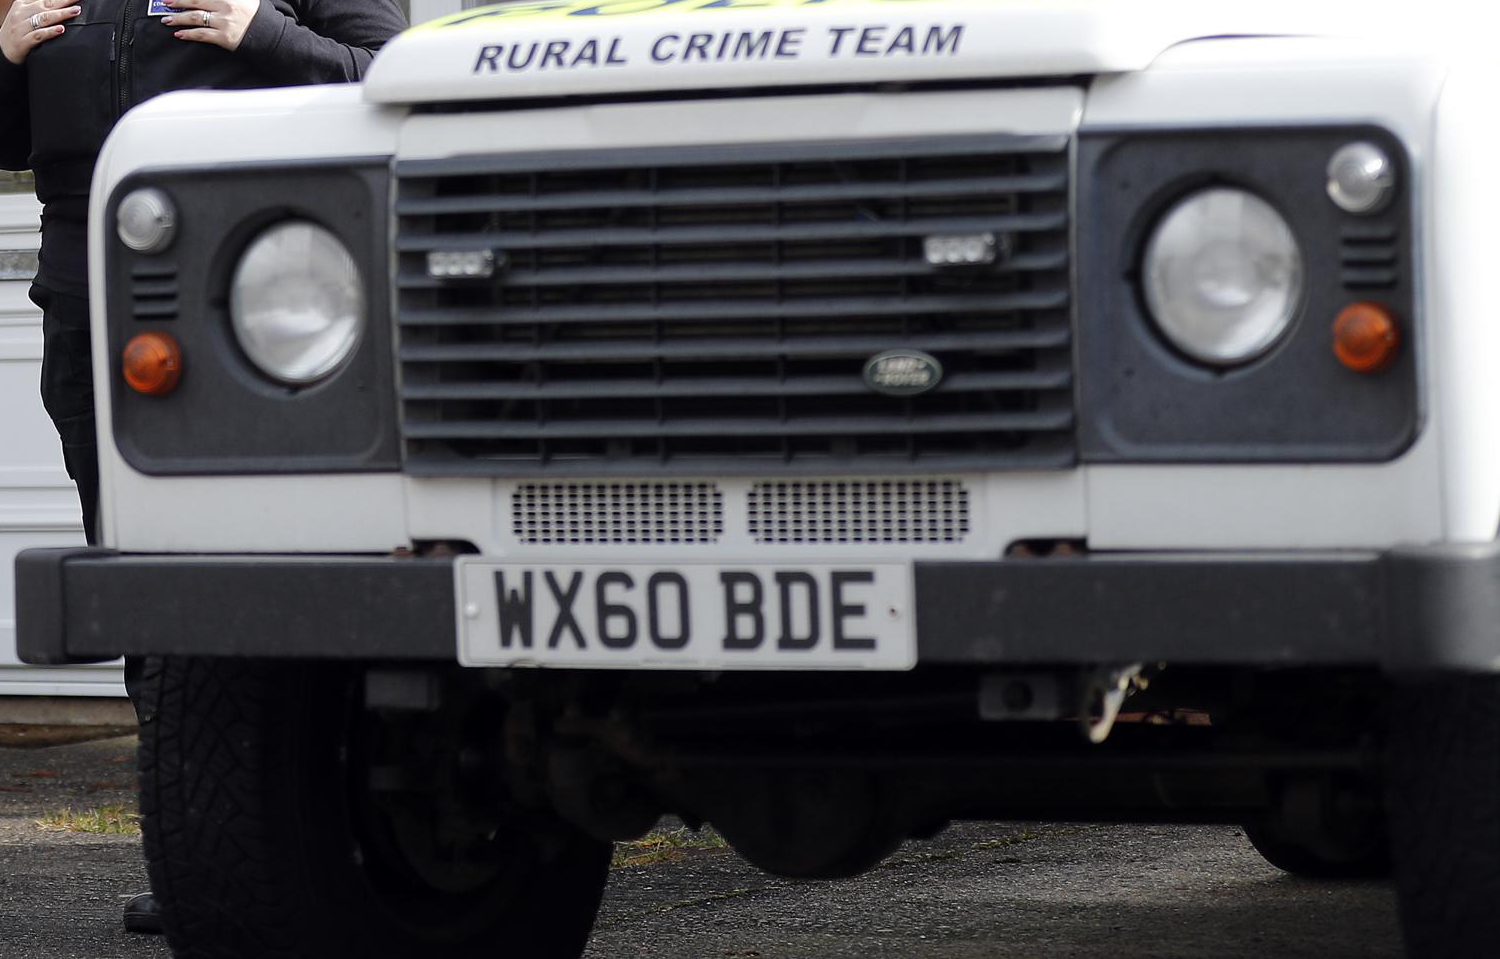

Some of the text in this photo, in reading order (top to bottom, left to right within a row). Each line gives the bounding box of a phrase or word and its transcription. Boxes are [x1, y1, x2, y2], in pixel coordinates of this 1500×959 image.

[473, 24, 966, 74] RURAL CRIME TEAM
[494, 570, 877, 651] WX60 BDE
